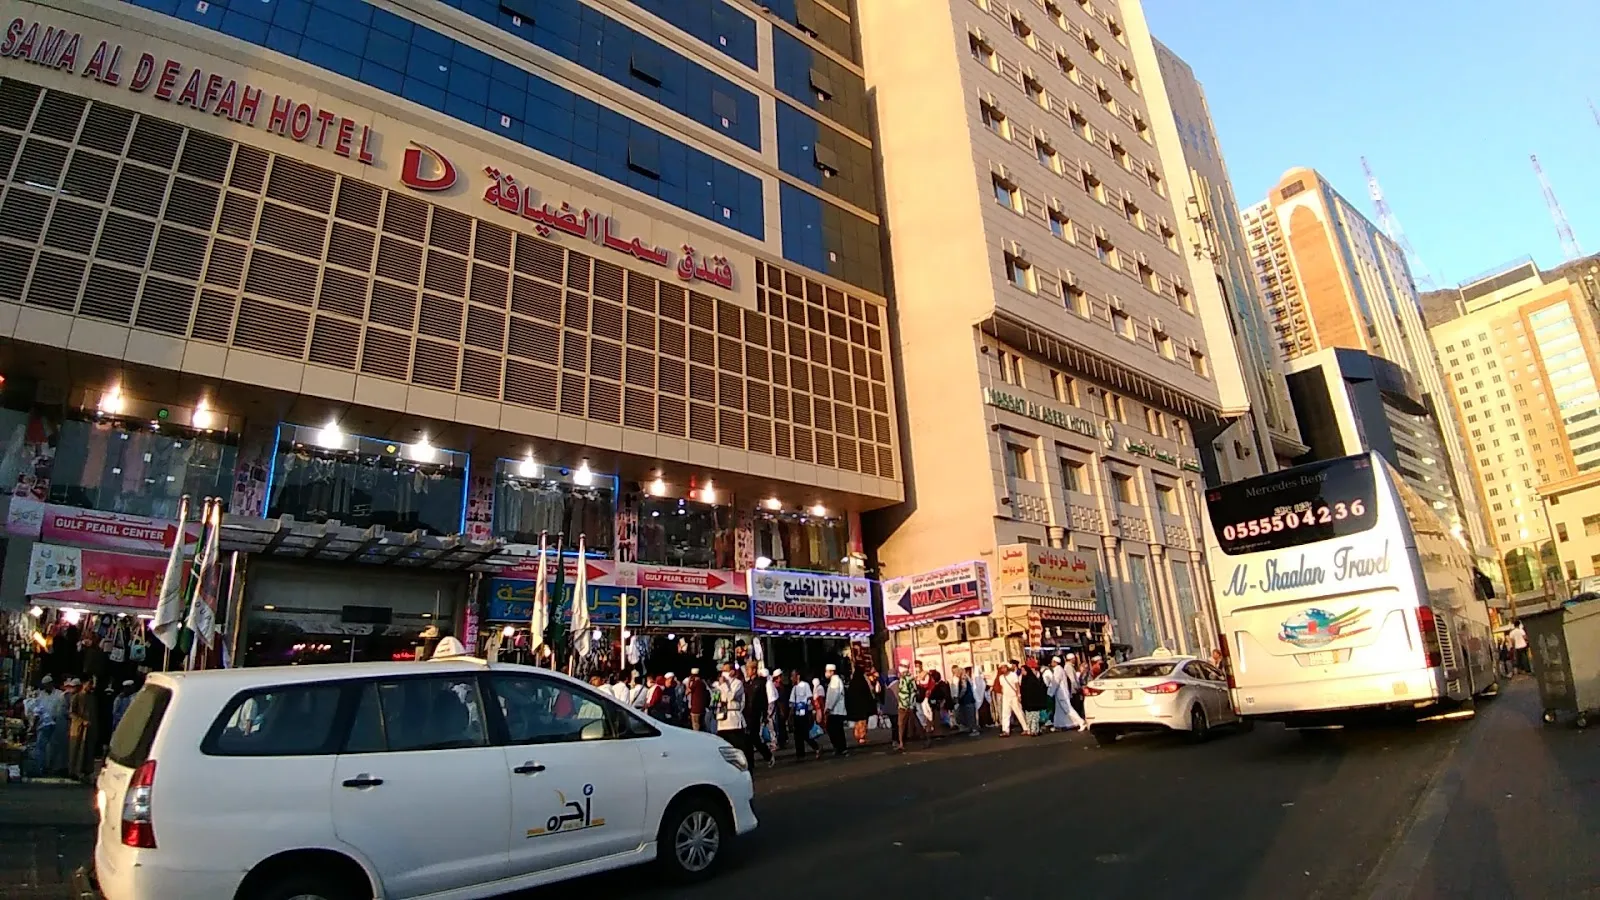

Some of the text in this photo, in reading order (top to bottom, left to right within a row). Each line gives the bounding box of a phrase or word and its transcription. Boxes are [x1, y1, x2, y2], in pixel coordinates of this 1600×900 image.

[1, 17, 375, 165] SAMA AL DEAFAH HOTEL
[482, 164, 735, 290] فندق سما الضيافة
[55, 518, 165, 541] GULF PEARL CENTER
[1223, 499, 1366, 541] 0555504236
[1334, 539, 1390, 582] Travel
[645, 573, 707, 584] GULF PEARL CENTER
[783, 578, 821, 603] الخليج
[716, 595, 748, 611] محل
[911, 581, 977, 608] MALL
[755, 601, 830, 618] SHOPPING
[833, 605, 869, 620] MALL
